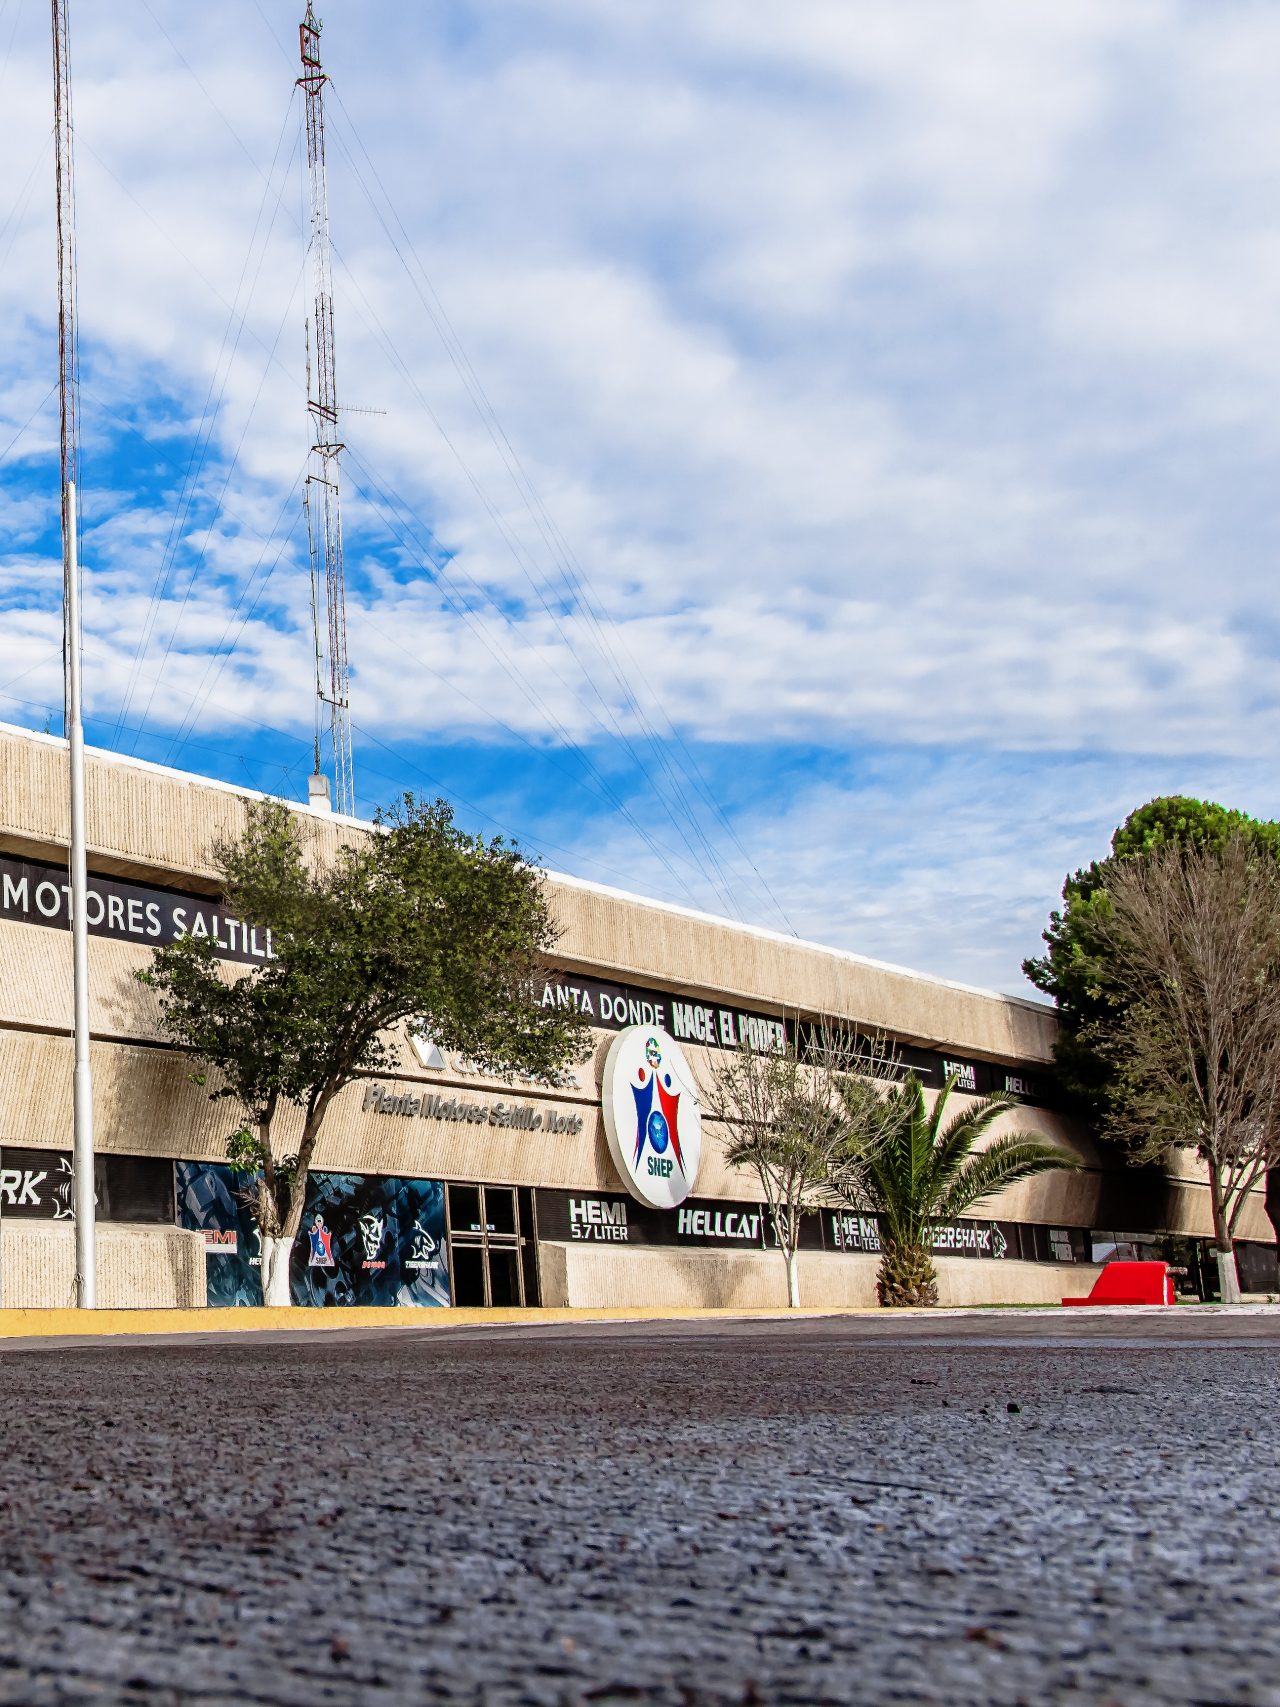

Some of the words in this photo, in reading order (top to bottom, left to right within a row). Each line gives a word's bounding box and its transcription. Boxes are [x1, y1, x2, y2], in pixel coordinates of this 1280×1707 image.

[3, 874, 162, 937] MOTORES
[173, 907, 296, 959] SALTILL
[600, 993, 665, 1030] DONDE
[672, 1001, 716, 1044] NACE
[719, 1010, 737, 1045] EL
[943, 1060, 976, 1081] HEMI
[362, 1085, 420, 1117] Planta
[420, 1093, 489, 1124] Motores
[489, 1103, 542, 1131] Saltillo
[647, 1155, 674, 1178] SNEP
[569, 1199, 628, 1226] HEMI
[677, 1208, 763, 1239] HELLCAT
[196, 1229, 237, 1244] EMI
[571, 1223, 592, 1239] 5.7
[594, 1225, 629, 1241] LITER
[832, 1216, 879, 1238] HEMI
